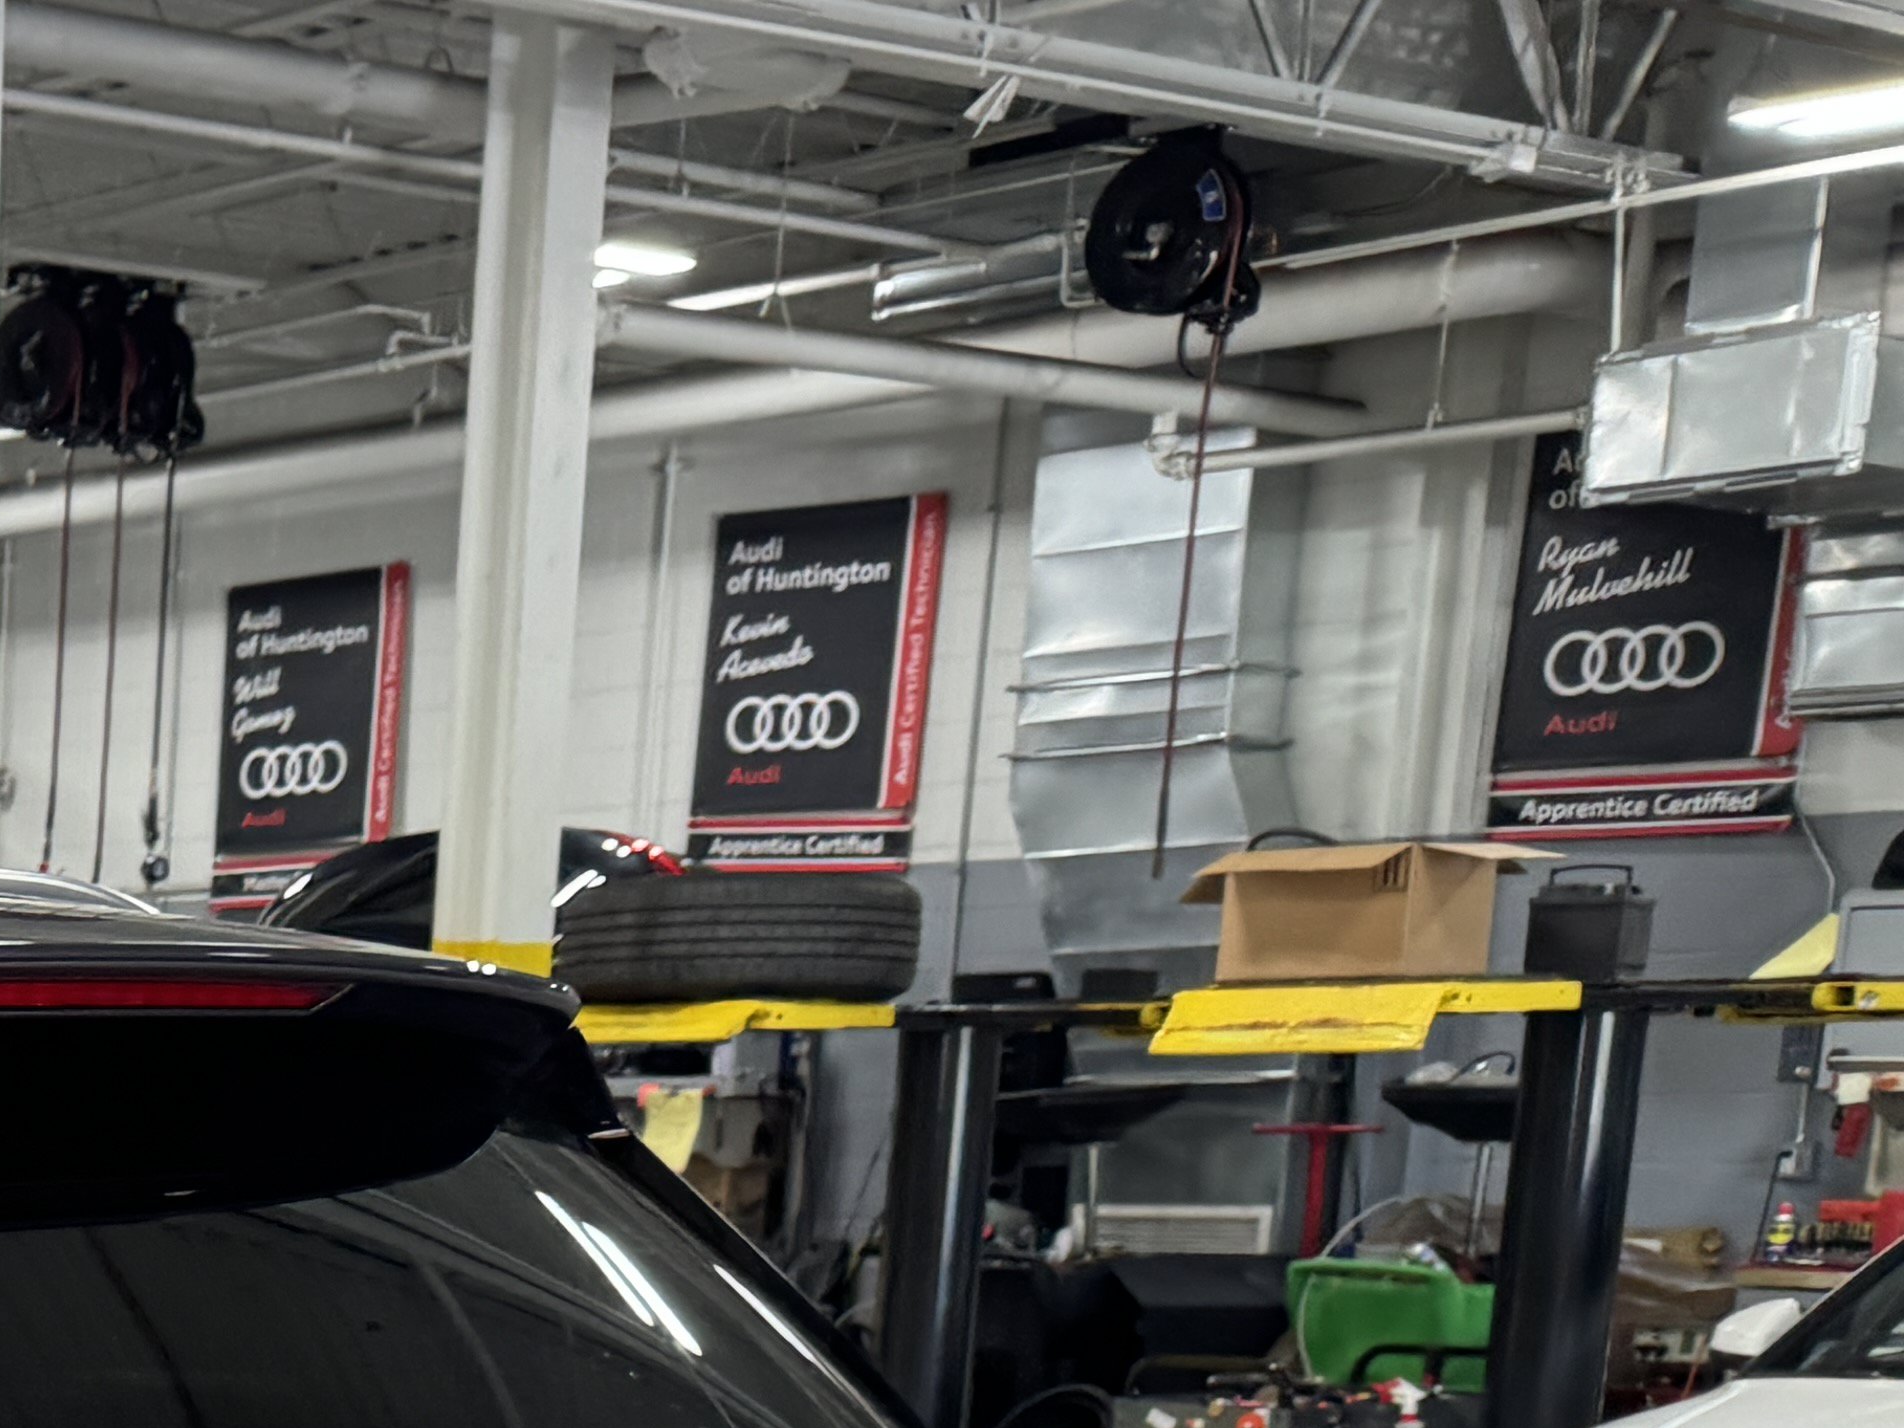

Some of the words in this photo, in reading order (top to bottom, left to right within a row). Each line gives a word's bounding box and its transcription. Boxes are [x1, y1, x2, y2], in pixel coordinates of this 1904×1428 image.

[728, 536, 784, 565] Audi
[1537, 535, 1621, 578] Ryan
[725, 567, 752, 595] of
[755, 561, 892, 593] Huntington
[908, 511, 938, 627] Technician
[1532, 546, 1694, 616] Mulvehill
[259, 624, 370, 655] Huntington
[719, 612, 792, 648] Kevin
[715, 634, 816, 684] Acevedo
[898, 633, 925, 729] Certified
[1543, 710, 1618, 737] Audi
[726, 763, 782, 786] Audi
[893, 733, 914, 786] Audi
[1518, 795, 1648, 825] Apprentice
[1652, 788, 1761, 816] Certified
[706, 834, 804, 858] Apprentice
[804, 833, 886, 856] Certified
